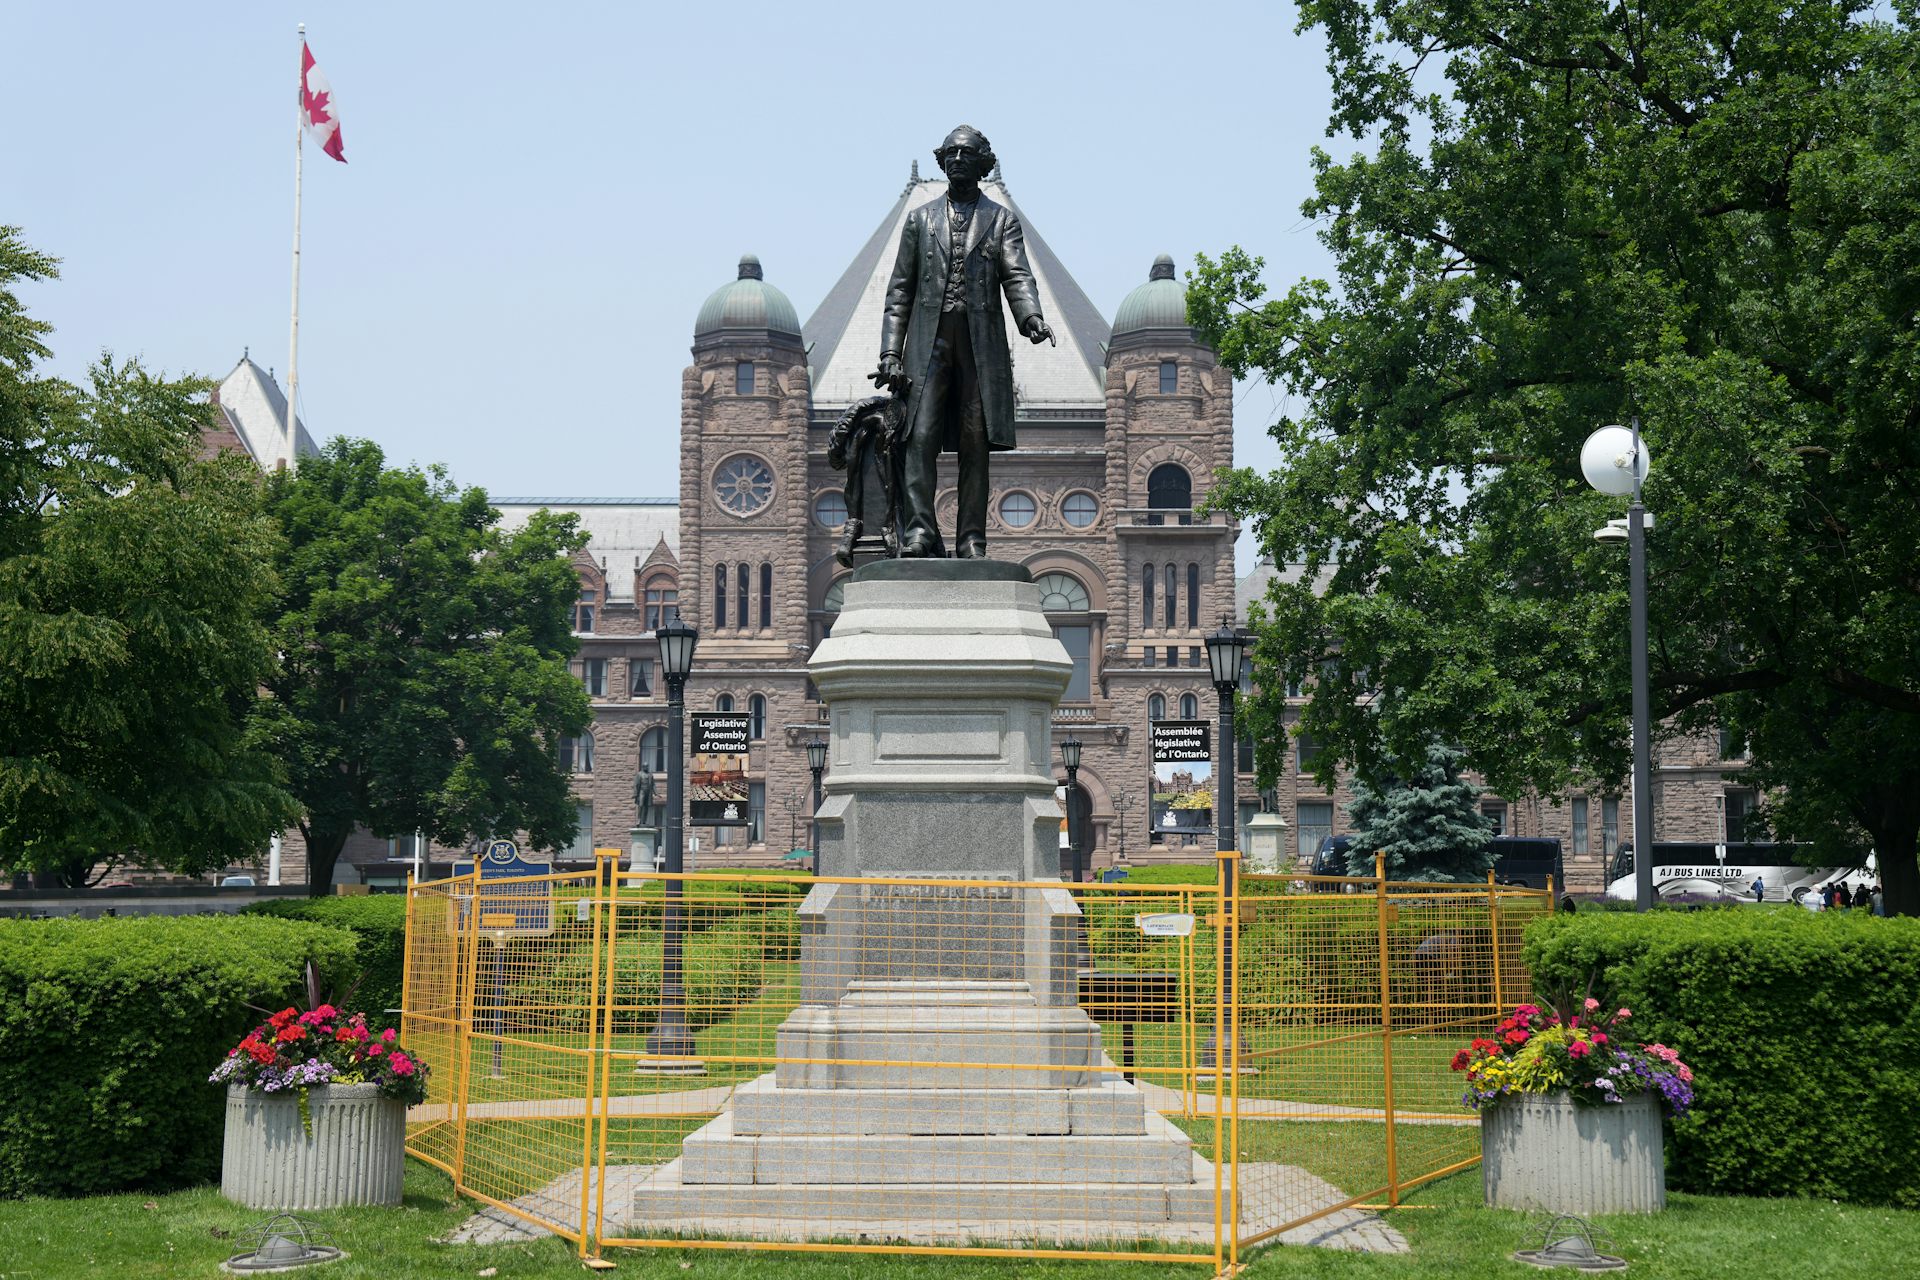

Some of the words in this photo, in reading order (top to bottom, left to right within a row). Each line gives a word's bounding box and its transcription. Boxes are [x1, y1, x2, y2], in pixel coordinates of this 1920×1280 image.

[699, 719, 747, 730] Legislative
[703, 730, 747, 741] Assembly
[1155, 726, 1203, 736] Assemblée
[699, 741, 711, 751] of
[711, 741, 747, 751] Ontario
[1155, 738, 1201, 749] législative
[1155, 749, 1167, 759] de
[1168, 749, 1209, 759] l'Ontario
[1674, 868, 1693, 877] BUS
[1695, 868, 1722, 877] LINES
[1725, 868, 1744, 877] LTD.
[868, 875, 1013, 899] MACDONALD
